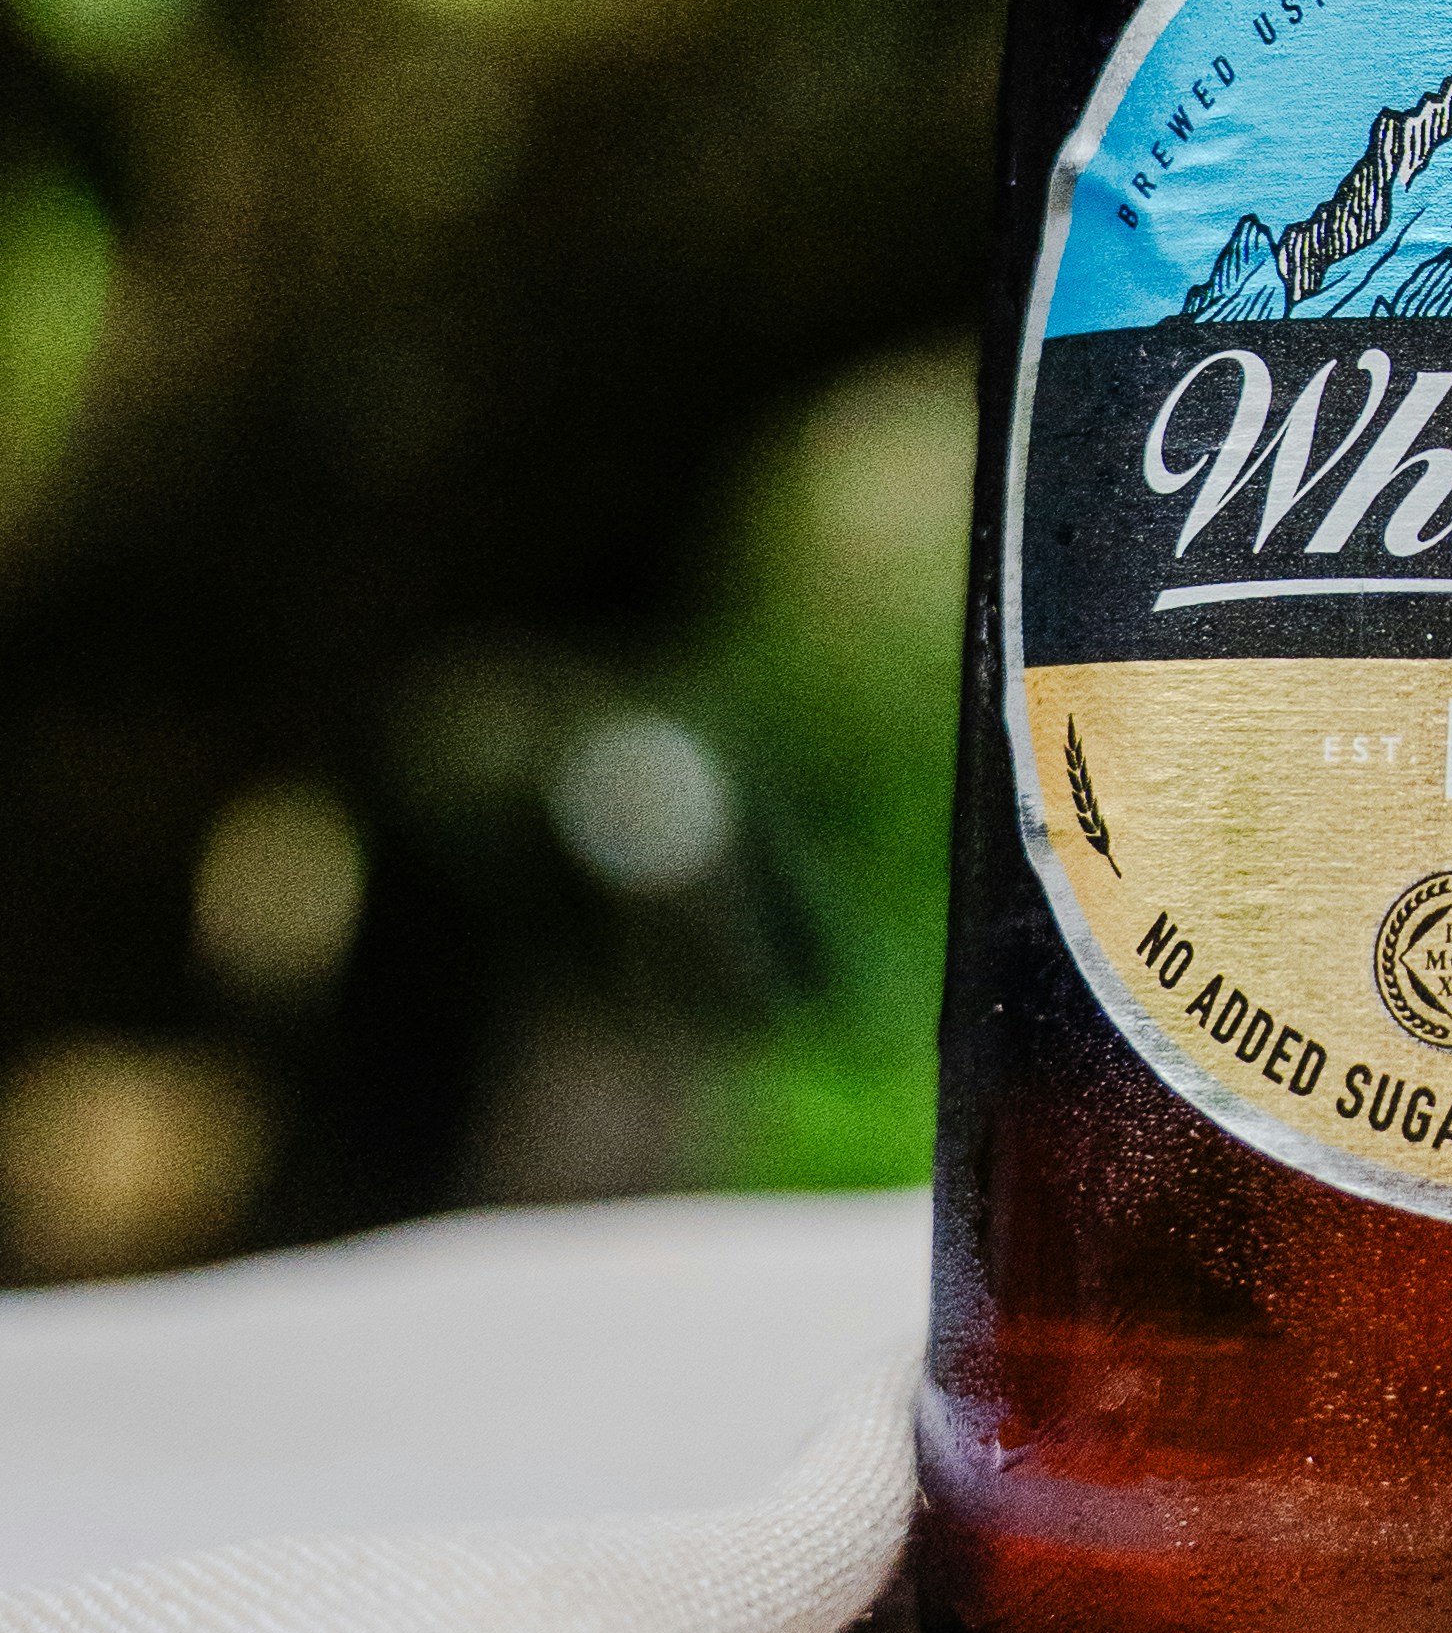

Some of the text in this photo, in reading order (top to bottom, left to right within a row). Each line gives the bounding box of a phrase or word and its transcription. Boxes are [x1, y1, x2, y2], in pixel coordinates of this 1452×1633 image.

[1117, 55, 1237, 230] BREWED
[1323, 735, 1419, 765] EST.
[1136, 911, 1195, 990] NO
[1185, 974, 1329, 1097] ADDED
